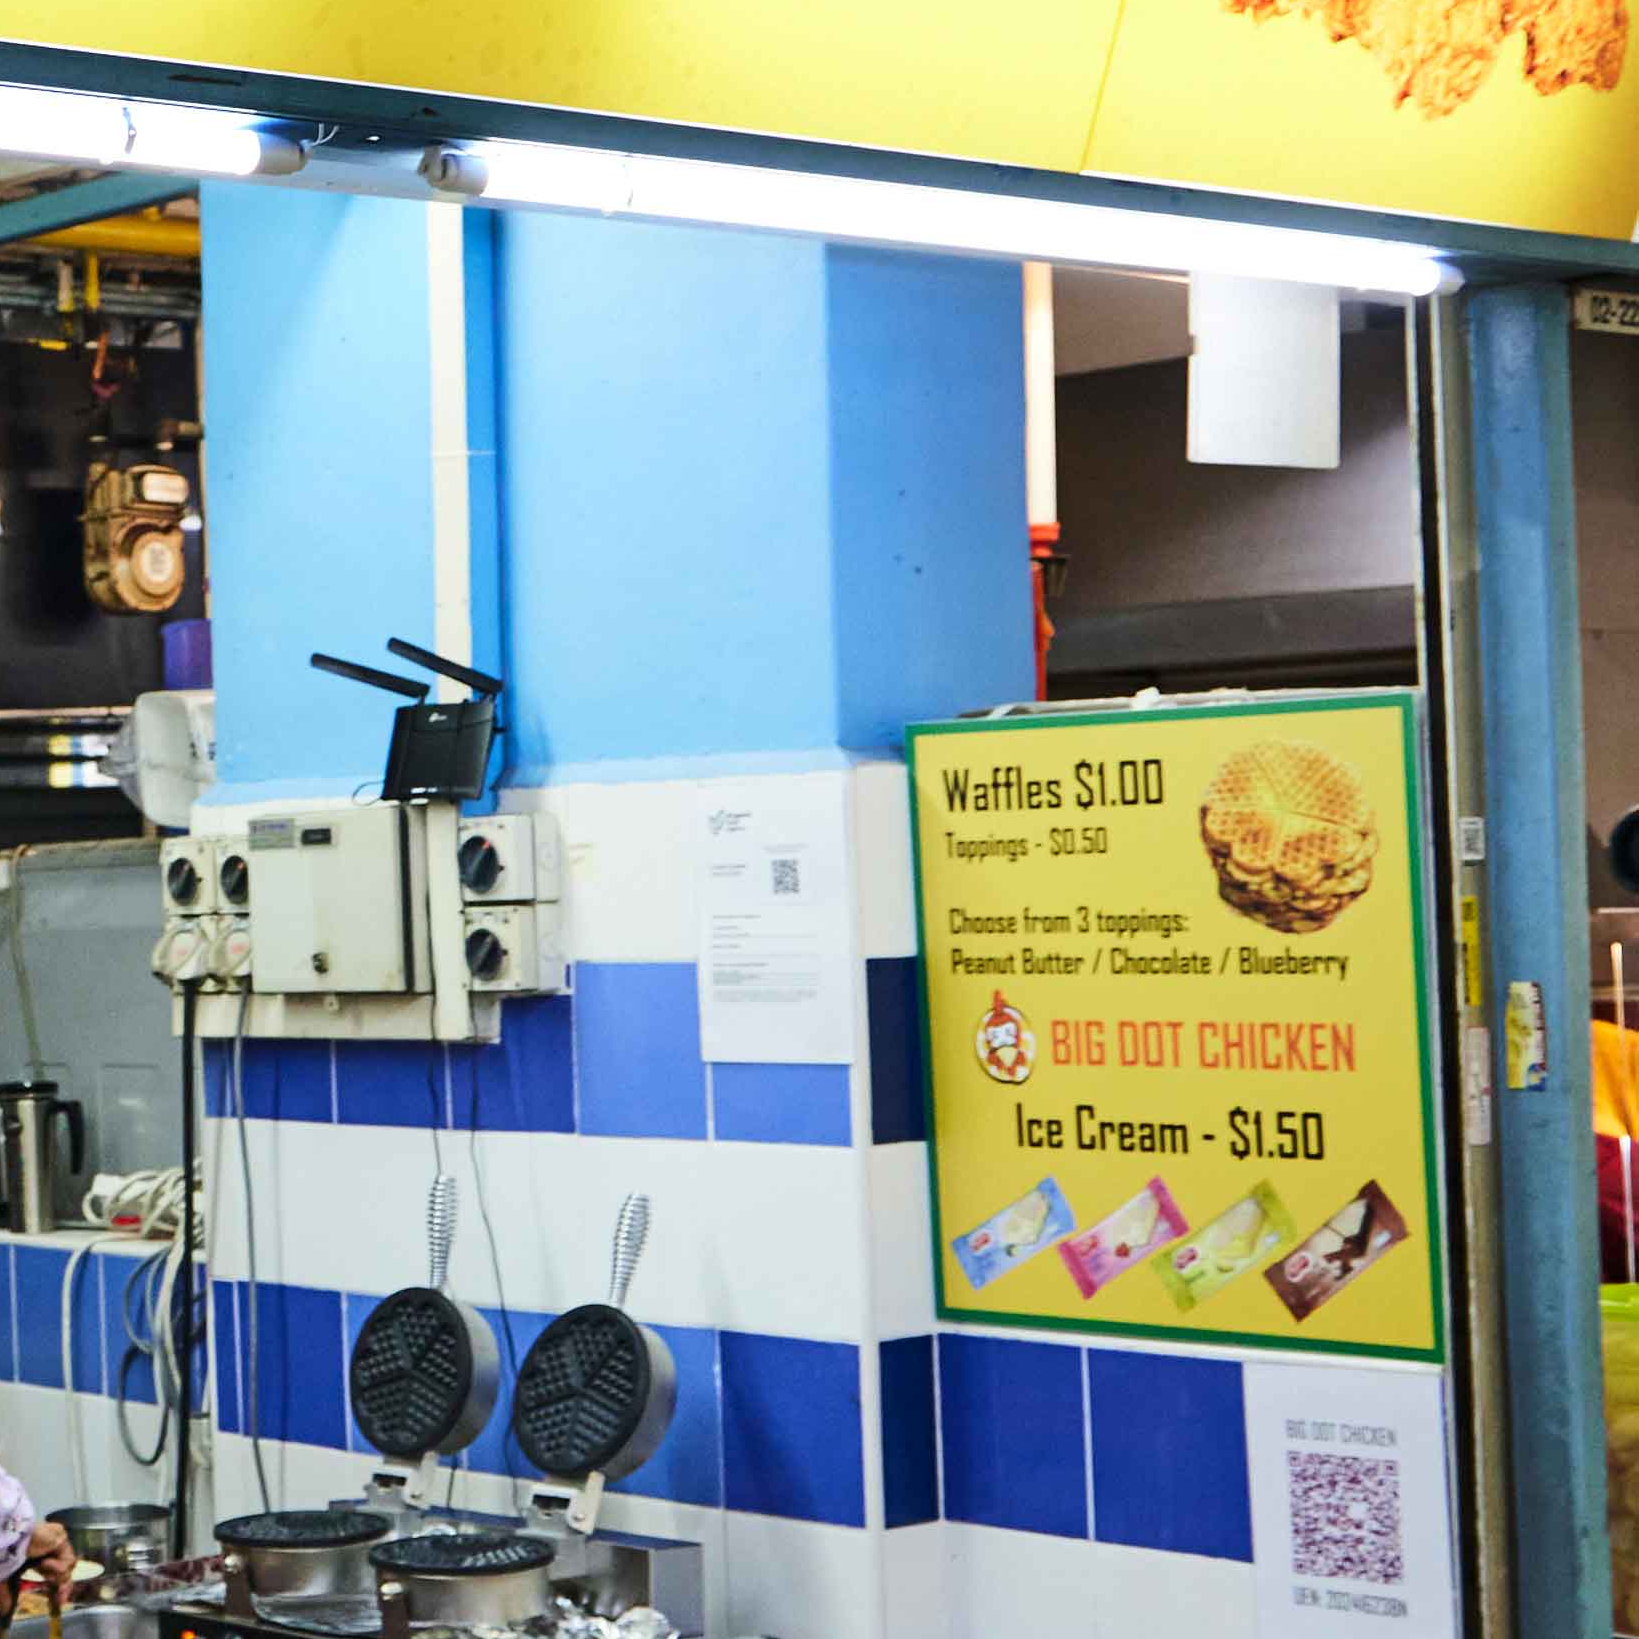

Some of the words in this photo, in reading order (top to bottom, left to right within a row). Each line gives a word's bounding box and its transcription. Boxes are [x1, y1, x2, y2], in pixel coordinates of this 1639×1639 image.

[943, 764, 1062, 813] Waffles
[1075, 758, 1163, 810] $1.00
[944, 830, 1028, 864] Toppings
[1049, 827, 1108, 857] $0.50
[949, 908, 1018, 937] Choose
[1024, 907, 1070, 935] from
[1076, 906, 1090, 934] 3
[1096, 907, 1189, 940] toppings:
[951, 948, 1017, 977] Peanut
[1022, 947, 1084, 976] Butter
[1111, 947, 1212, 976] Chocolate
[1239, 947, 1349, 981] Blueberry
[1051, 1019, 1105, 1066] BIG
[1119, 1021, 1184, 1068] DOT
[1199, 1021, 1356, 1072] CHICKEN
[1016, 1103, 1063, 1148] Ice
[1076, 1104, 1189, 1155] Cream
[1229, 1106, 1324, 1160] $1.50
[1340, 1423, 1396, 1447] CHICKEN
